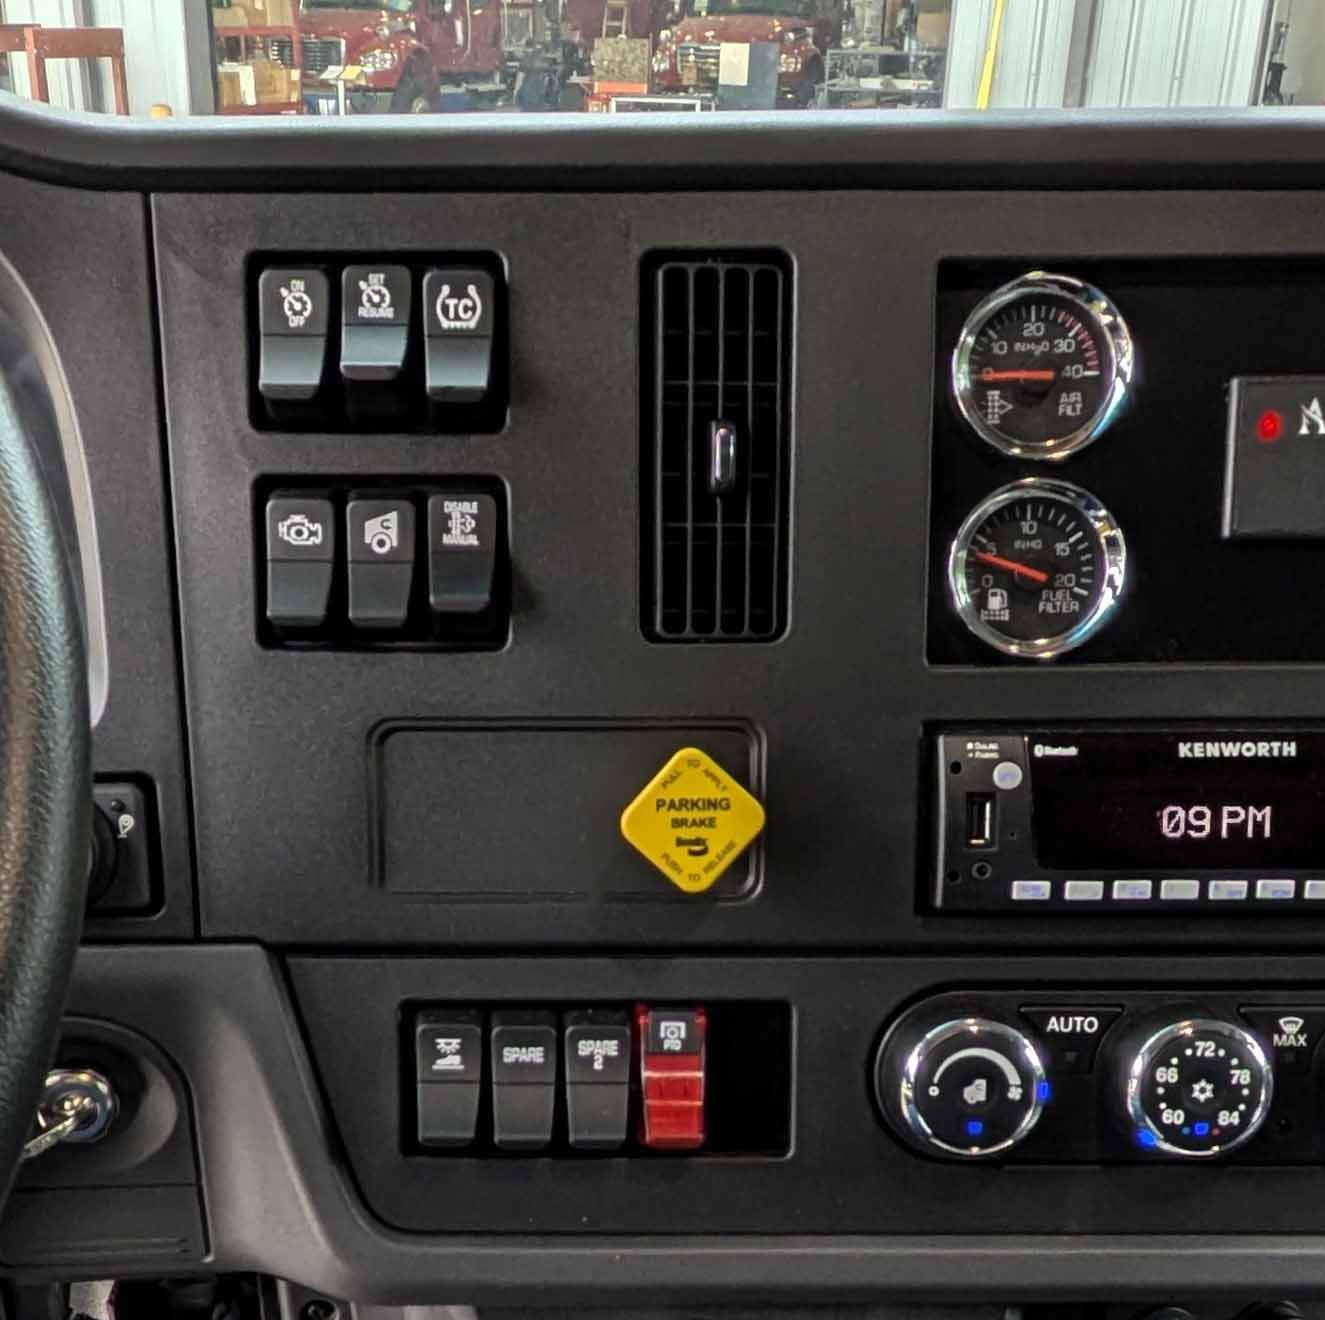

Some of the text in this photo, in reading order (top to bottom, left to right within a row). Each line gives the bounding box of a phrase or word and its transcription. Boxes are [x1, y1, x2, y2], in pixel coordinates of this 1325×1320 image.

[445, 299, 473, 319] TC
[1023, 323, 1045, 336] 20
[992, 341, 1008, 355] 10
[1055, 339, 1075, 353] 30
[1062, 365, 1083, 378] 40
[1060, 392, 1081, 403] AIR
[1058, 404, 1082, 416] FILT
[1020, 521, 1037, 535] 10
[1055, 543, 1070, 556] 15
[982, 575, 993, 588] 0
[1055, 574, 1076, 587] 20
[1042, 590, 1072, 600] FUEL
[1038, 602, 1079, 613] FILTER
[1178, 741, 1297, 758] KENWORTH
[656, 798, 730, 812] PARKING
[671, 817, 717, 828] BRAKE
[1162, 805, 1272, 838] 09 PM
[1046, 1016, 1099, 1033] AUTO
[1273, 1034, 1307, 1047] MAX
[503, 1047, 544, 1063] SPARE
[578, 1040, 619, 1056] SPARE
[1194, 1041, 1215, 1058] 72
[1156, 1066, 1179, 1083] 66
[1230, 1069, 1251, 1085] 78
[1161, 1109, 1185, 1125] 60
[1218, 1110, 1240, 1127] 84
